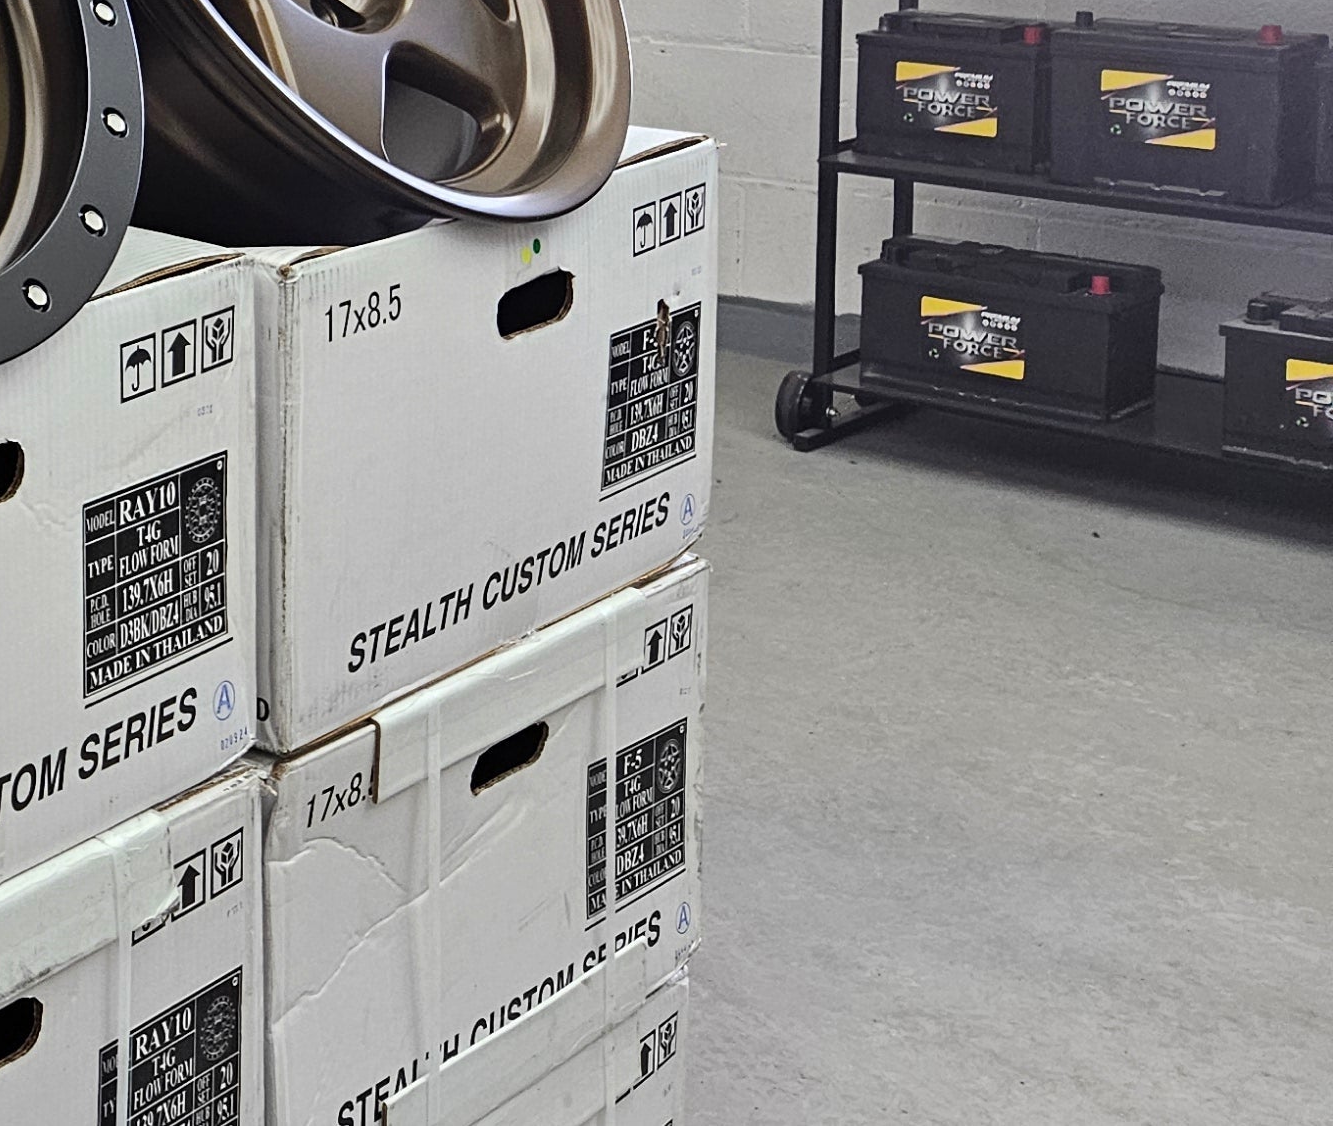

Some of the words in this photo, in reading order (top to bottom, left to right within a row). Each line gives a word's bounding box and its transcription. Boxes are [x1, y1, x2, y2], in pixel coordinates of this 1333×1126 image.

[903, 87, 990, 107] POWER
[917, 101, 975, 118] FORCE
[1109, 97, 1207, 118] POWER
[1126, 113, 1191, 130] FORCE
[324, 283, 401, 342] 17x8.5
[928, 323, 1017, 349] POWER
[943, 338, 1002, 359] FORCE
[610, 376, 628, 397] TYPE
[631, 424, 659, 454] DBZ4
[605, 457, 633, 484] MADE
[634, 452, 645, 470] IN
[645, 434, 693, 466] THAILAND
[85, 509, 115, 533] MODEL
[118, 481, 176, 525] RAY10
[136, 519, 161, 547] T4G
[87, 554, 115, 579] TYPE
[118, 549, 149, 579] FLOW
[150, 534, 179, 565] FORM
[183, 557, 197, 574] OFF
[206, 548, 220, 576] 20
[121, 568, 174, 613] 139.7X6H
[183, 572, 198, 589] SET
[347, 584, 473, 673] STEALTH
[482, 530, 585, 611] CUSTOM
[591, 491, 671, 558] SERIES
[86, 633, 116, 659] COLOR
[119, 599, 180, 650] D3BK/DBZ4
[89, 655, 132, 690] MADE
[135, 645, 151, 668] IN
[151, 614, 223, 662] THAILAND
[77, 686, 199, 781] SERIES
[623, 748, 643, 776] F-5
[616, 842, 645, 876] DBZ4
[633, 849, 682, 888] THAILAND
[135, 1007, 192, 1061] RAY10
[133, 1075, 162, 1111] FLOW
[164, 1057, 193, 1091] FORM
[219, 1062, 233, 1091] 20
